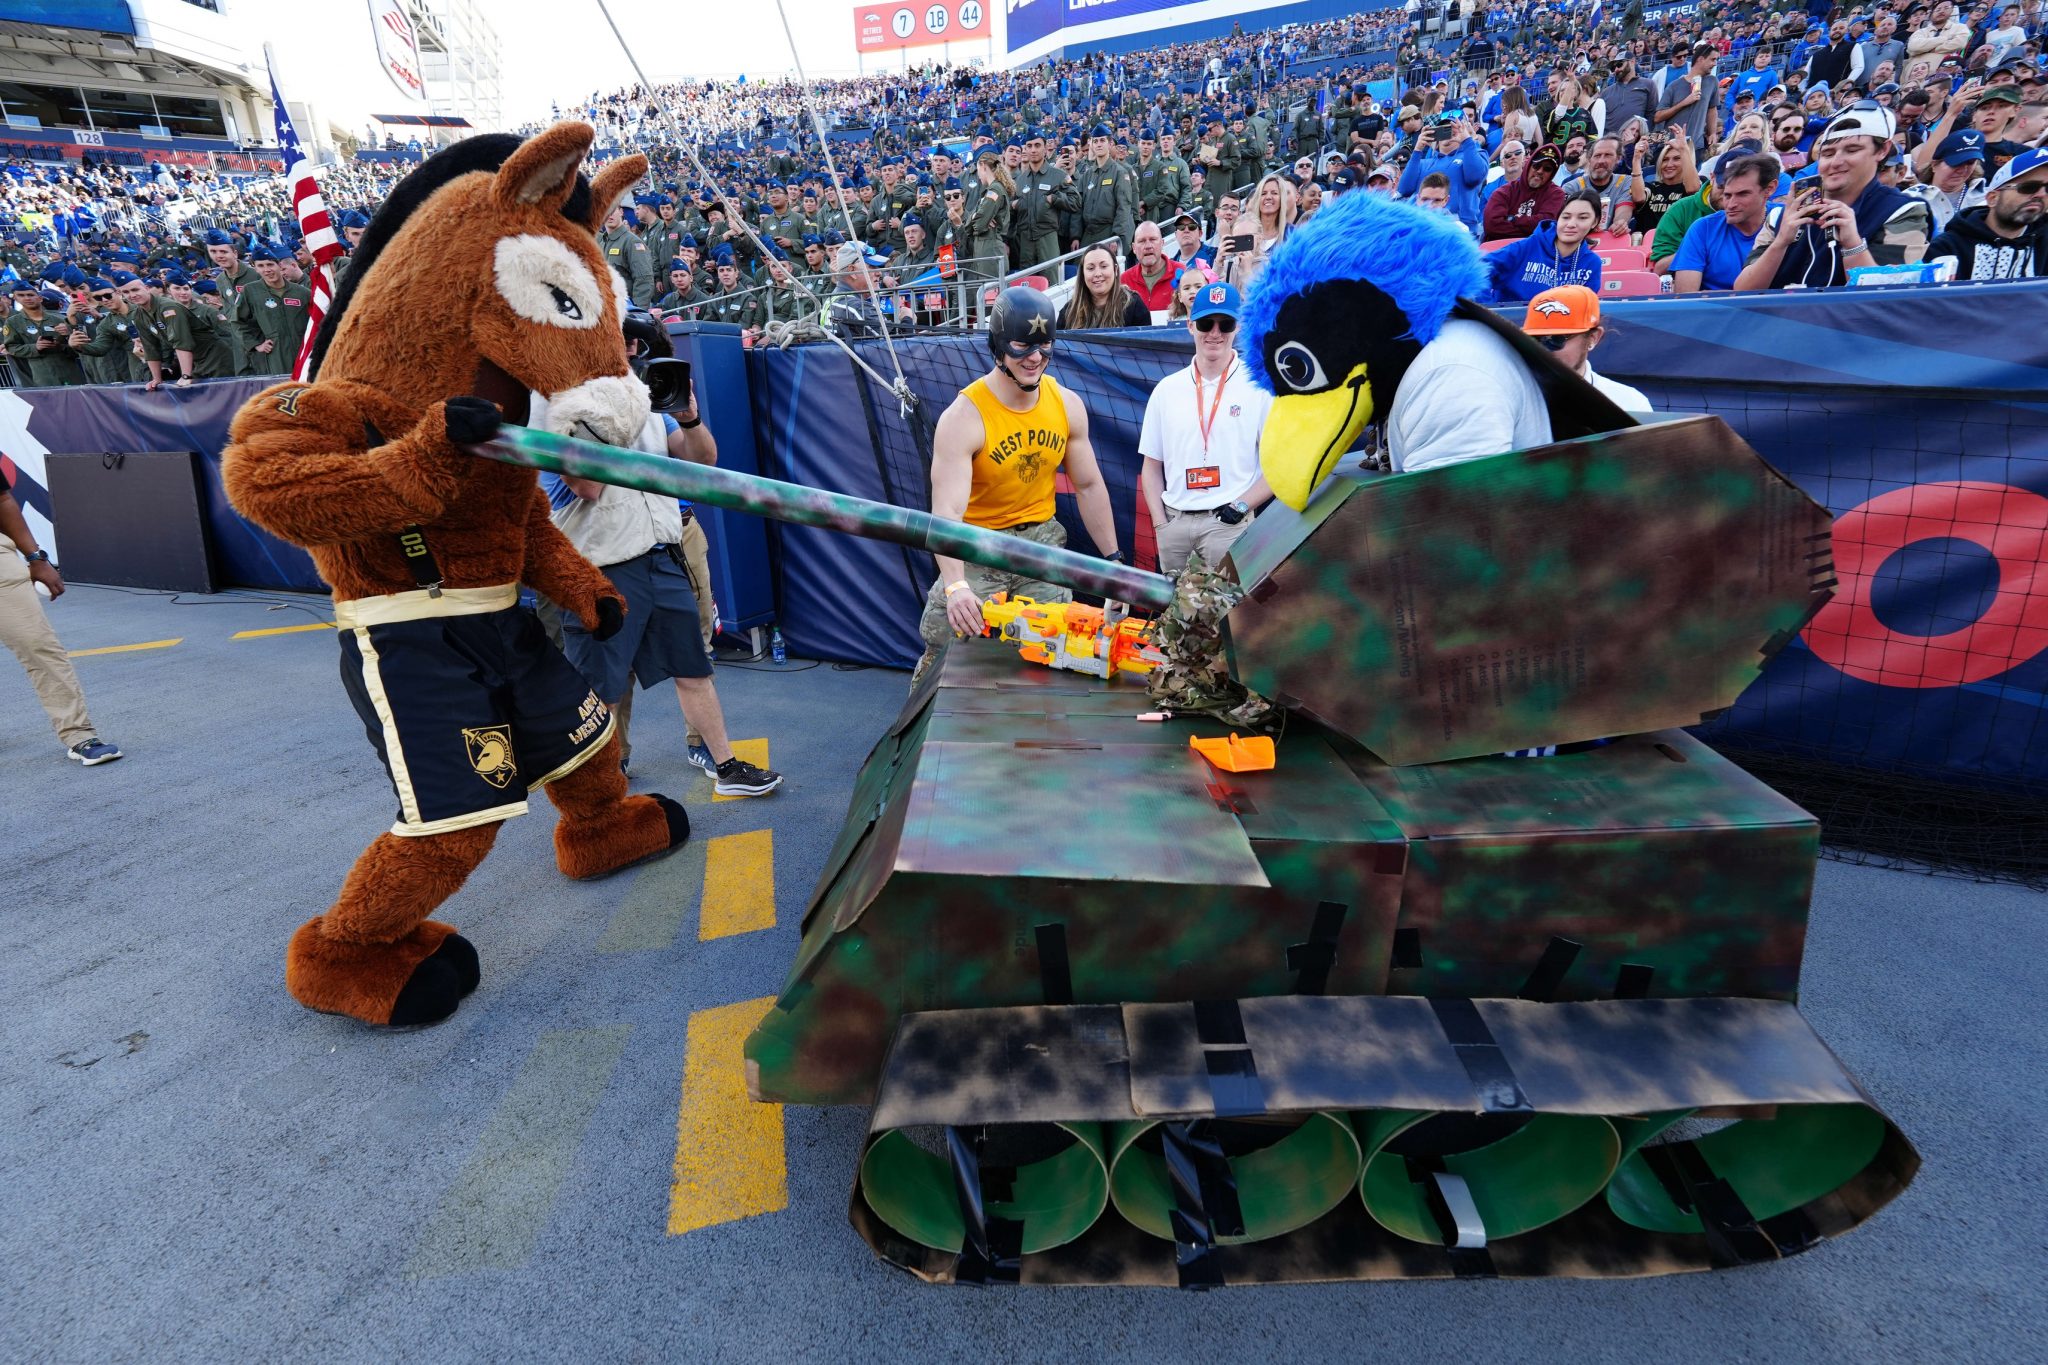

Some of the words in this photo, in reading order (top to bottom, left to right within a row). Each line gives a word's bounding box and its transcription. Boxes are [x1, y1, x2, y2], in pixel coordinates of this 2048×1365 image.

[929, 10, 945, 28] 18
[962, 6, 979, 23] 44
[1669, 5, 1699, 17] FIEL
[899, 15, 907, 31] 7
[76, 132, 102, 145] 128
[1521, 272, 1535, 283] AIR
[1525, 261, 1556, 279] UNITED
[989, 431, 1022, 465] WEST
[1028, 429, 1067, 453] POINT
[400, 532, 428, 558] GO
[578, 688, 600, 721] ARMY
[568, 711, 602, 745] WEST
